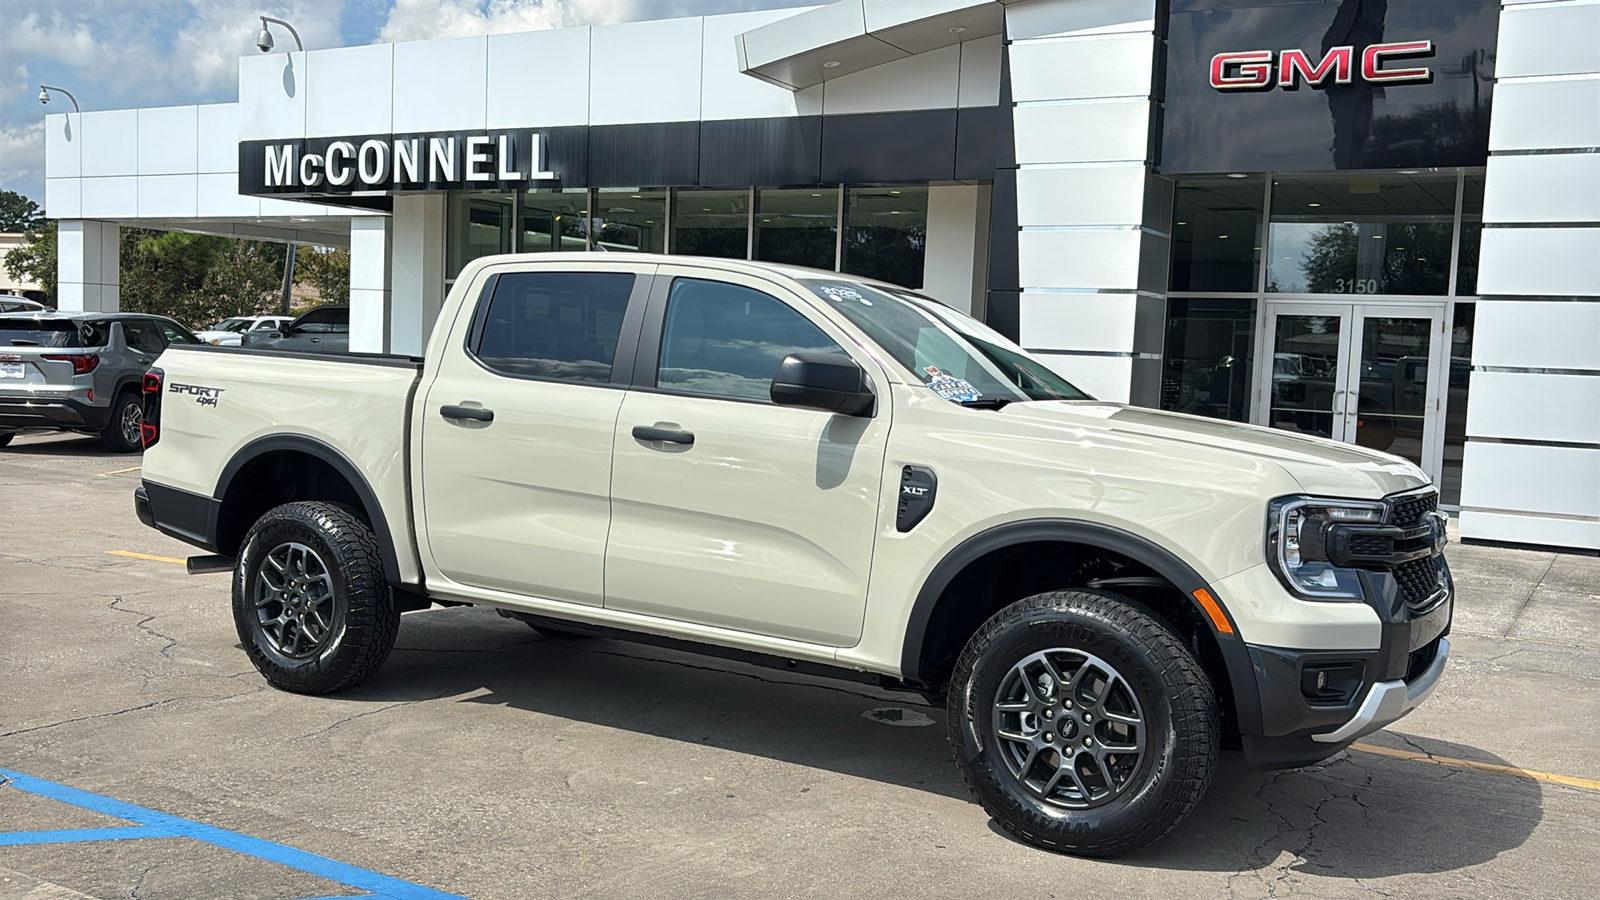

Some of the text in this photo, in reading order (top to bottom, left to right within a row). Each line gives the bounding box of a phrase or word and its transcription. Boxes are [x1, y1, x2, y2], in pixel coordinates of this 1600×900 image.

[1209, 40, 1432, 89] GMC
[264, 133, 558, 187] McCONNELL
[1335, 278, 1377, 294] 3150
[169, 383, 226, 398] SPORT
[903, 486, 928, 496] XLT
